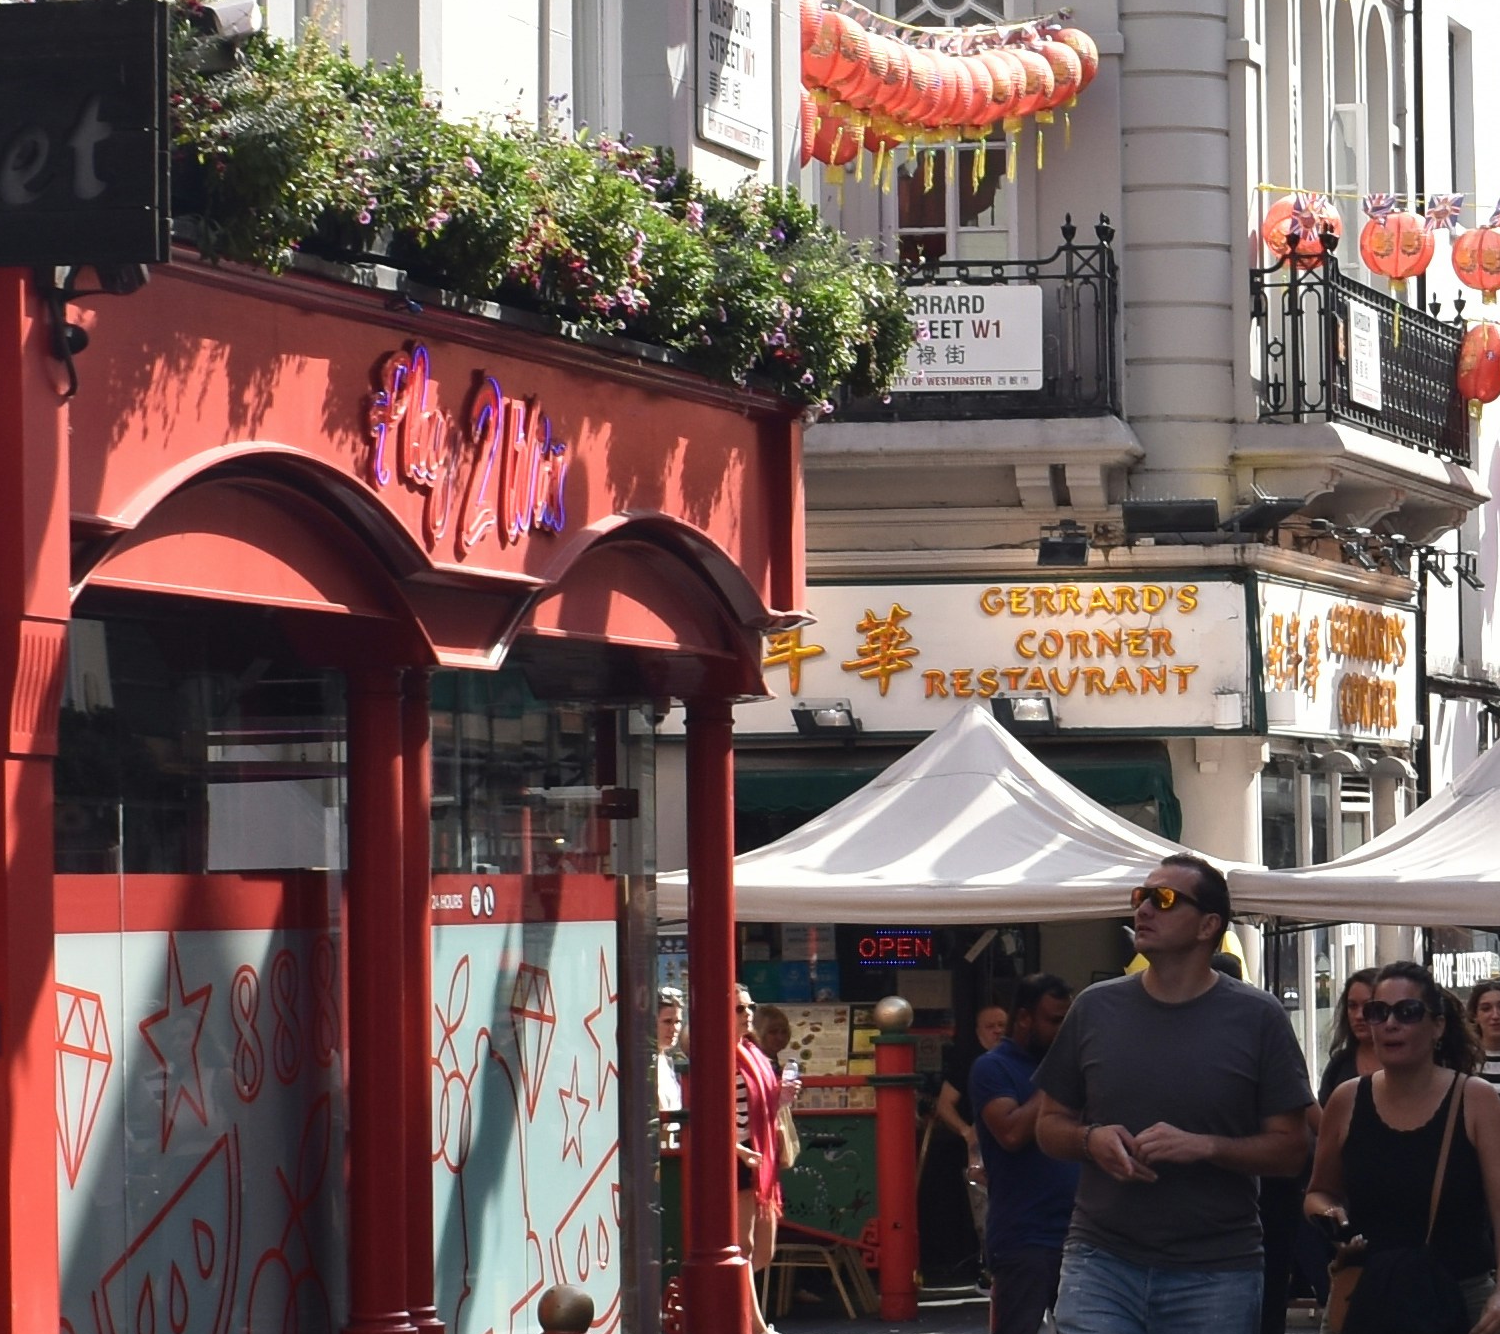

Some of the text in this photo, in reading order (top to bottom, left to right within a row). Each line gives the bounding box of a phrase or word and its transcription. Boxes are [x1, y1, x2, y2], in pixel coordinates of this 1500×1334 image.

[916, 295, 985, 314] RRARD
[972, 321, 1002, 339] W1
[915, 377, 925, 386] OF
[927, 376, 993, 386] WESTMINSTER
[980, 584, 1200, 616] GERRARD'S
[1014, 627, 1176, 658] CORNER
[923, 664, 1198, 698] RESTAURANT
[859, 938, 931, 957] OPEN
[1432, 952, 1454, 988] HOT
